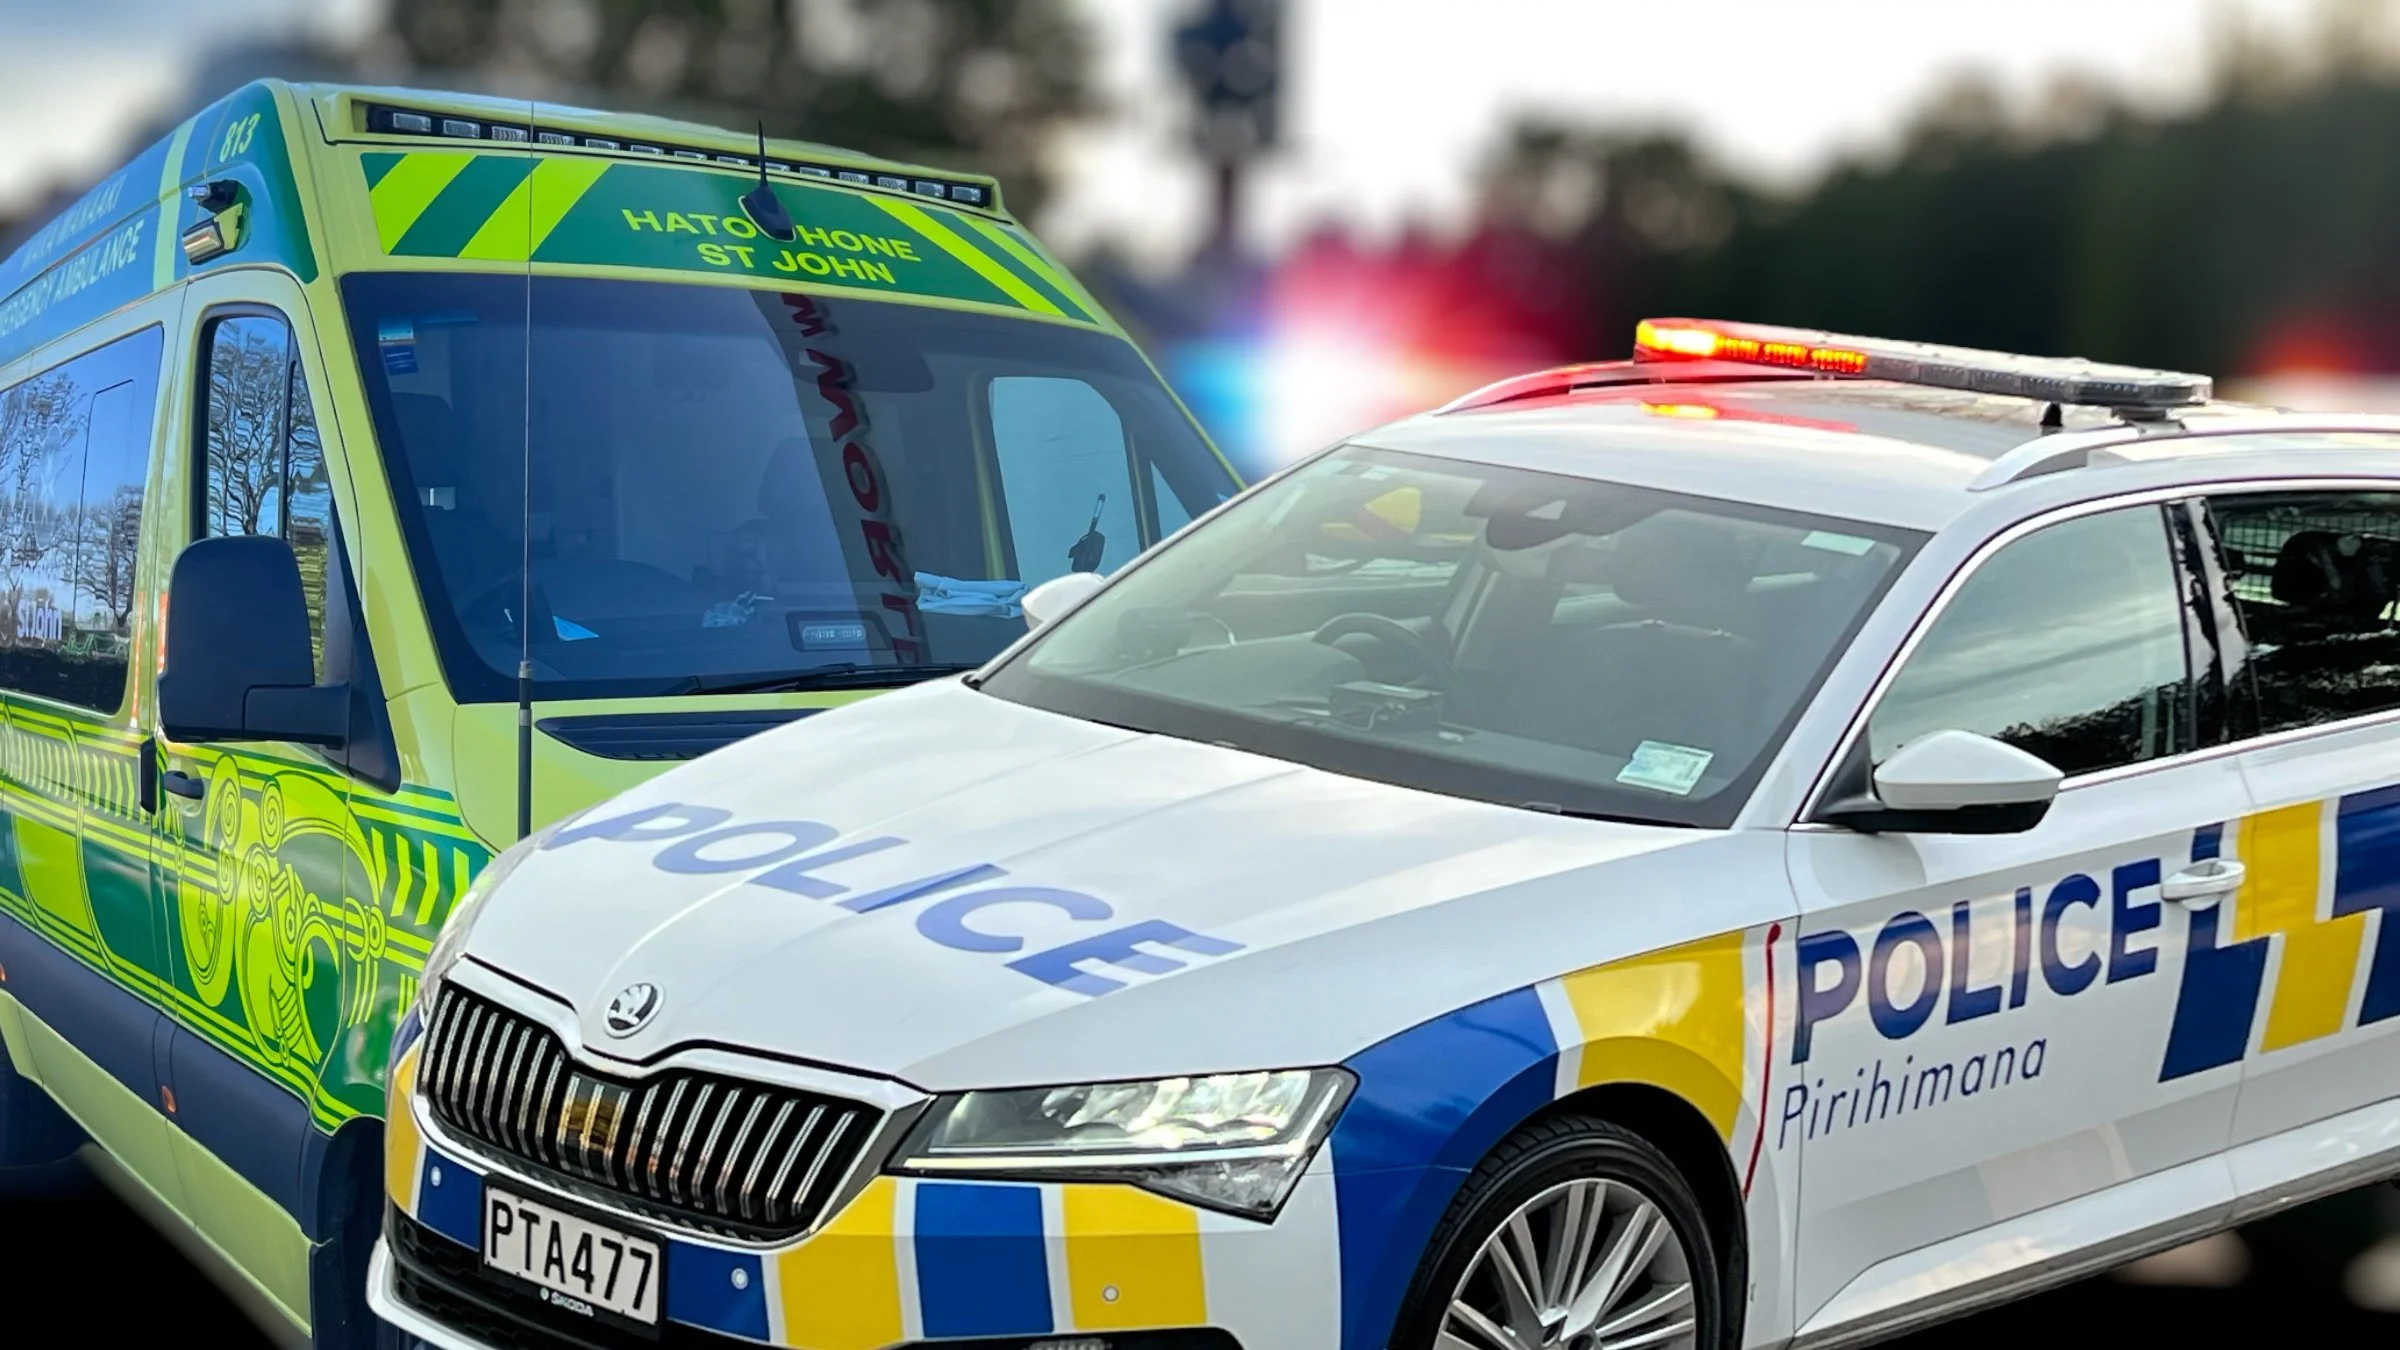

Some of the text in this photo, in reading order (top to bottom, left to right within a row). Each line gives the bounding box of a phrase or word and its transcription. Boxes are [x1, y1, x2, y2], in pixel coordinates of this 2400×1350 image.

[219, 112, 261, 163] 813
[52, 218, 145, 306] AMBULANCE
[621, 208, 923, 263] HATO HONE
[696, 242, 897, 285] ST JOHN
[538, 802, 1248, 999] POLICE
[1791, 857, 2162, 1066] POLICE
[1778, 1038, 2048, 1151] Pirihimana
[490, 1198, 653, 1311] PTA477
